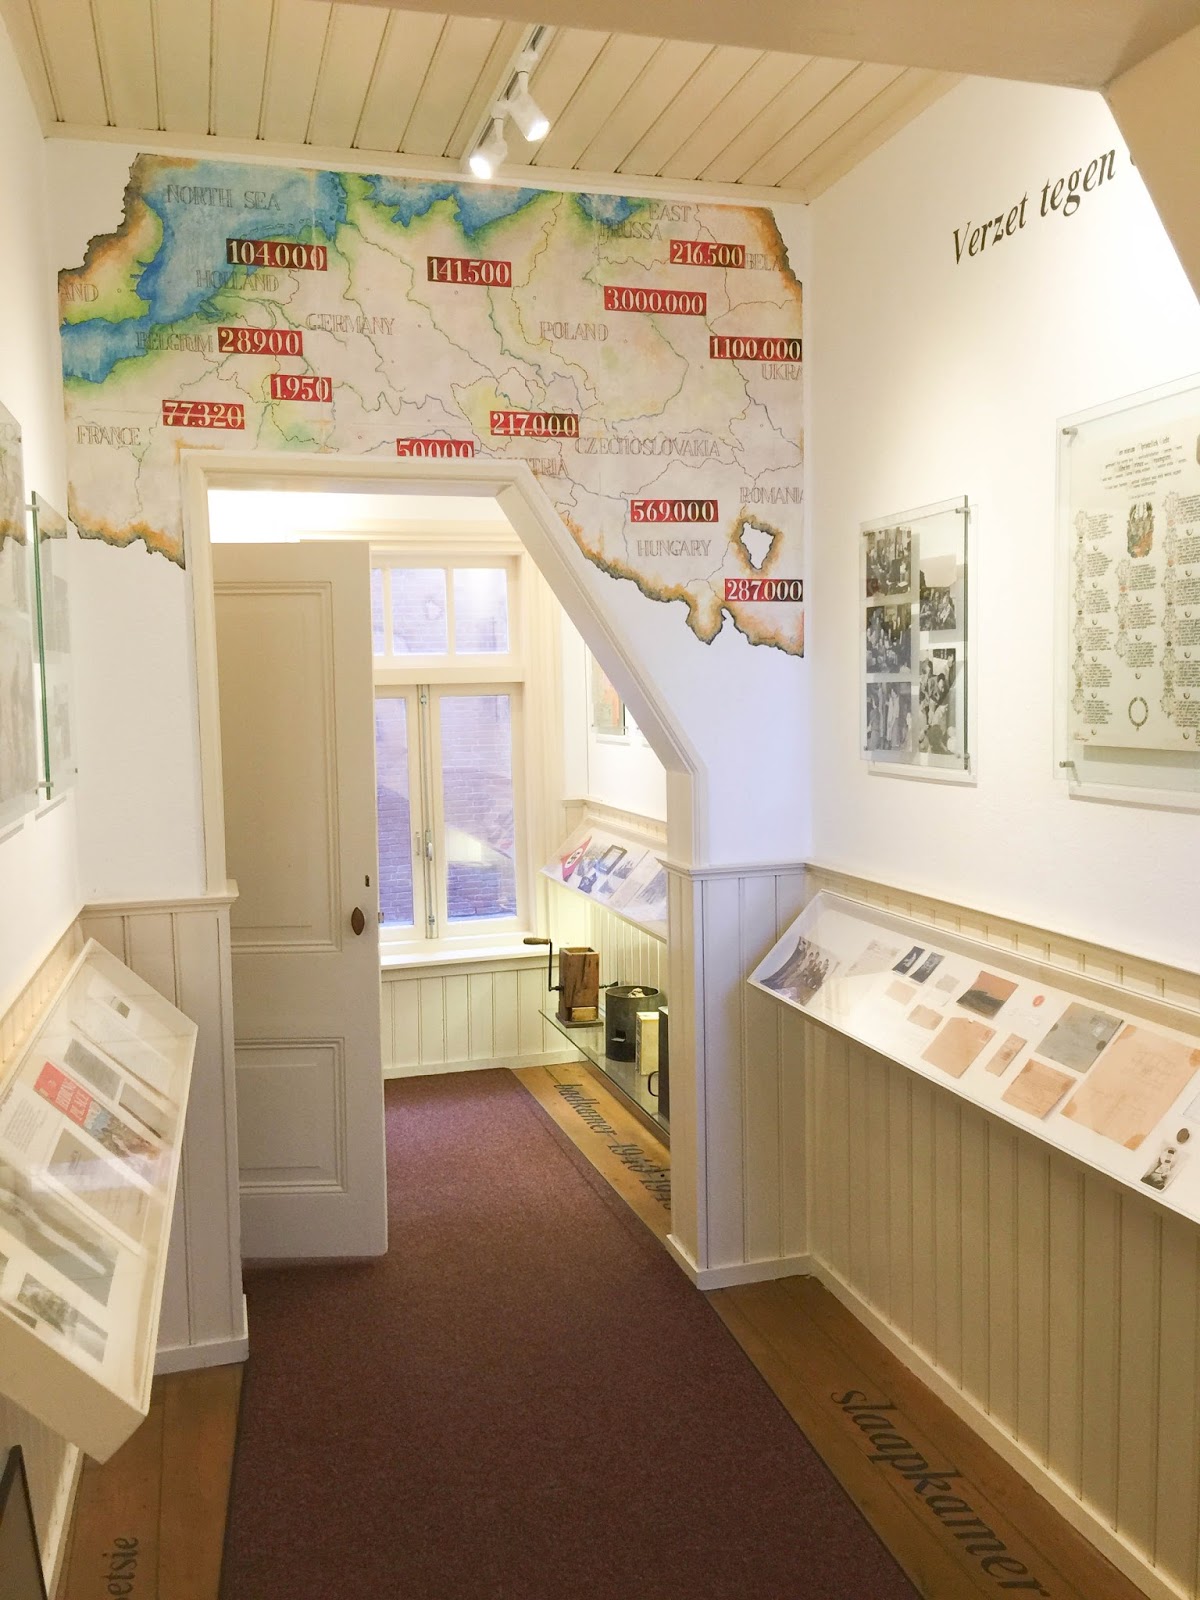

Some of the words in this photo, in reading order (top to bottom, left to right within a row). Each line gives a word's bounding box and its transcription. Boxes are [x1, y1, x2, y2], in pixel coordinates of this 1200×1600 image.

[167, 184, 232, 209] NORTH
[244, 190, 281, 211] SEA
[953, 191, 1028, 264] Verzet
[1041, 150, 1116, 216] tegen
[648, 203, 692, 222] EAST
[228, 239, 325, 270] 104.000
[673, 242, 743, 266] 216.500
[196, 270, 279, 292] HOLLAND
[429, 257, 511, 285] 141.500
[607, 288, 704, 314] 3.000.000
[305, 313, 396, 335] GERMANY
[540, 321, 609, 342] POLAND
[135, 331, 213, 352] BELGIUM
[221, 329, 299, 354] 28.900
[713, 337, 801, 360] 1.100.000
[274, 376, 329, 401] 1.950
[164, 402, 243, 428] 77.320
[492, 411, 577, 437] 217.000
[77, 425, 142, 446] FRANCE
[575, 436, 720, 458] CZECHOSLOVAKIA
[633, 500, 714, 522] 569.000
[637, 539, 712, 558] HUNGARY
[726, 579, 802, 601] 287.000
[102, 1537, 138, 1600] etsie
